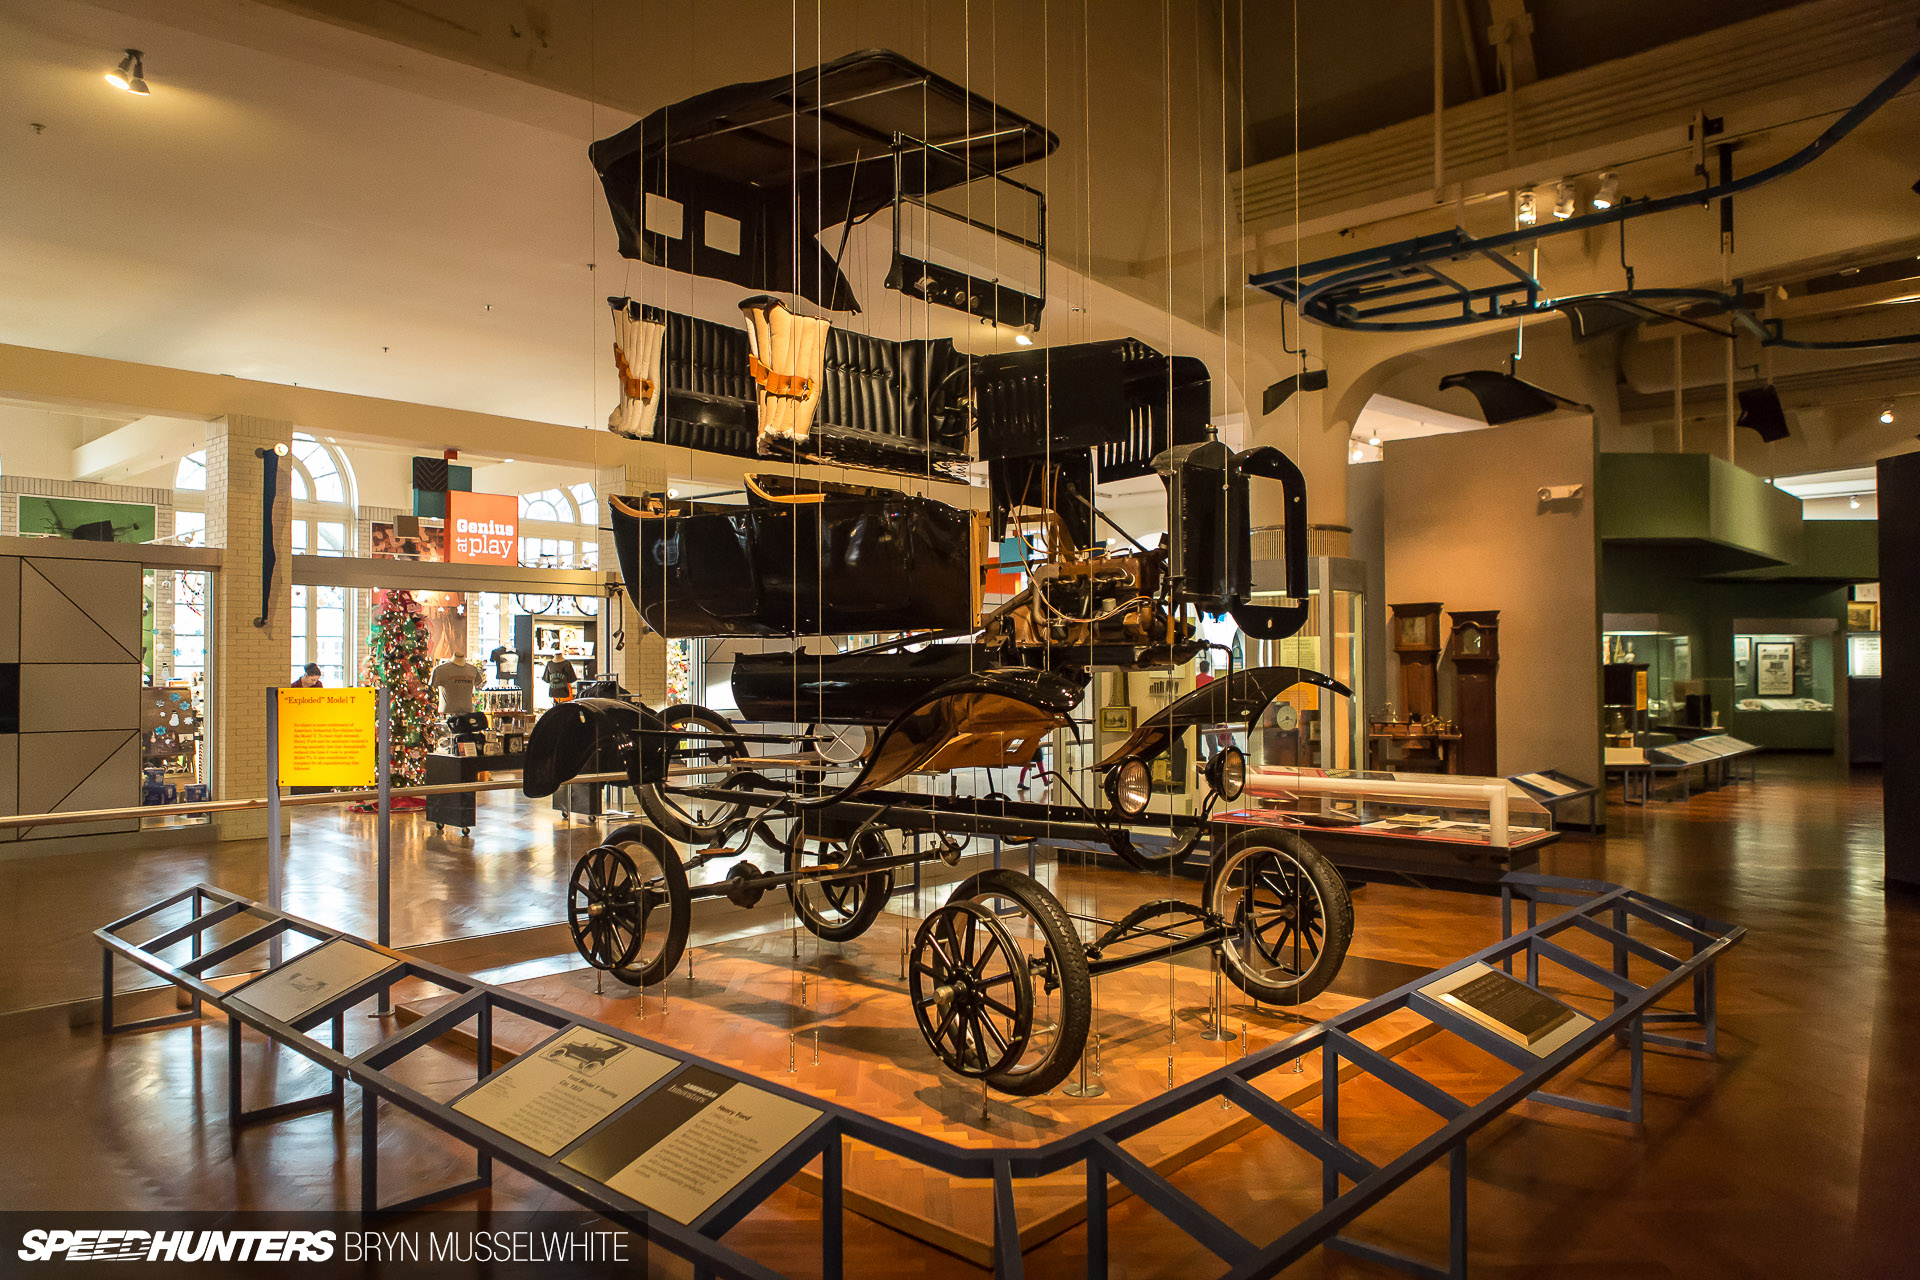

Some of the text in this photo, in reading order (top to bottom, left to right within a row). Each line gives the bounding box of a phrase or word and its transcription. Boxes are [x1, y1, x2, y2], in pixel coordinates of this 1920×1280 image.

[456, 518, 514, 536] Genius
[456, 535, 513, 559] at play
[327, 696, 348, 704] Model
[350, 696, 356, 704] T
[667, 1084, 708, 1103] Innovators
[683, 1082, 719, 1099] AMERICAN
[717, 1104, 734, 1116] Henry
[735, 1111, 752, 1122] Ford
